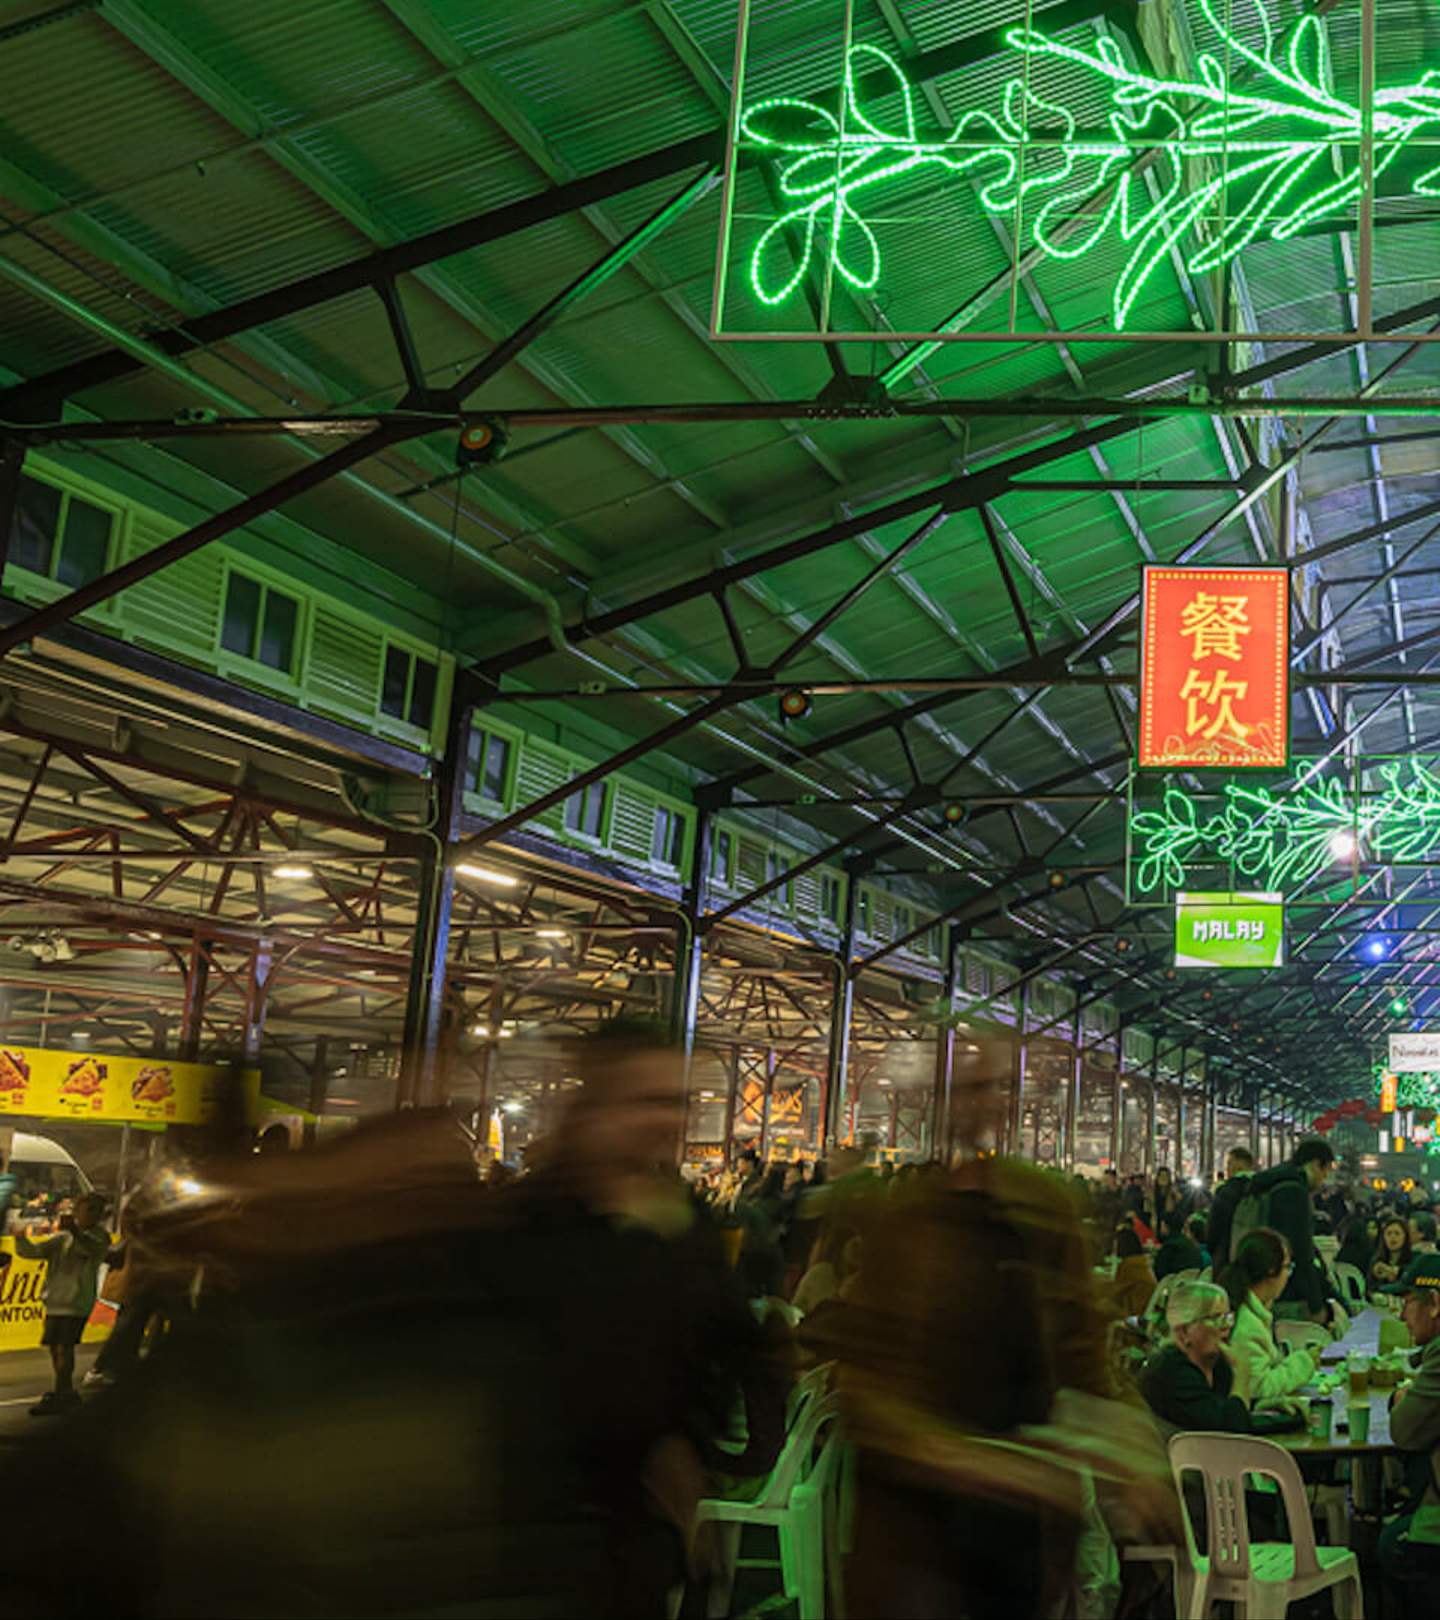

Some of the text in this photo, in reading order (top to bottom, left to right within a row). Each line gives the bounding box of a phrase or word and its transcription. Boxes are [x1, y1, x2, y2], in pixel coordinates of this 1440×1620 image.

[1179, 591, 1251, 738] 餐饮
[1193, 920, 1264, 943] MALAY
[0, 1306, 43, 1322] NTON
